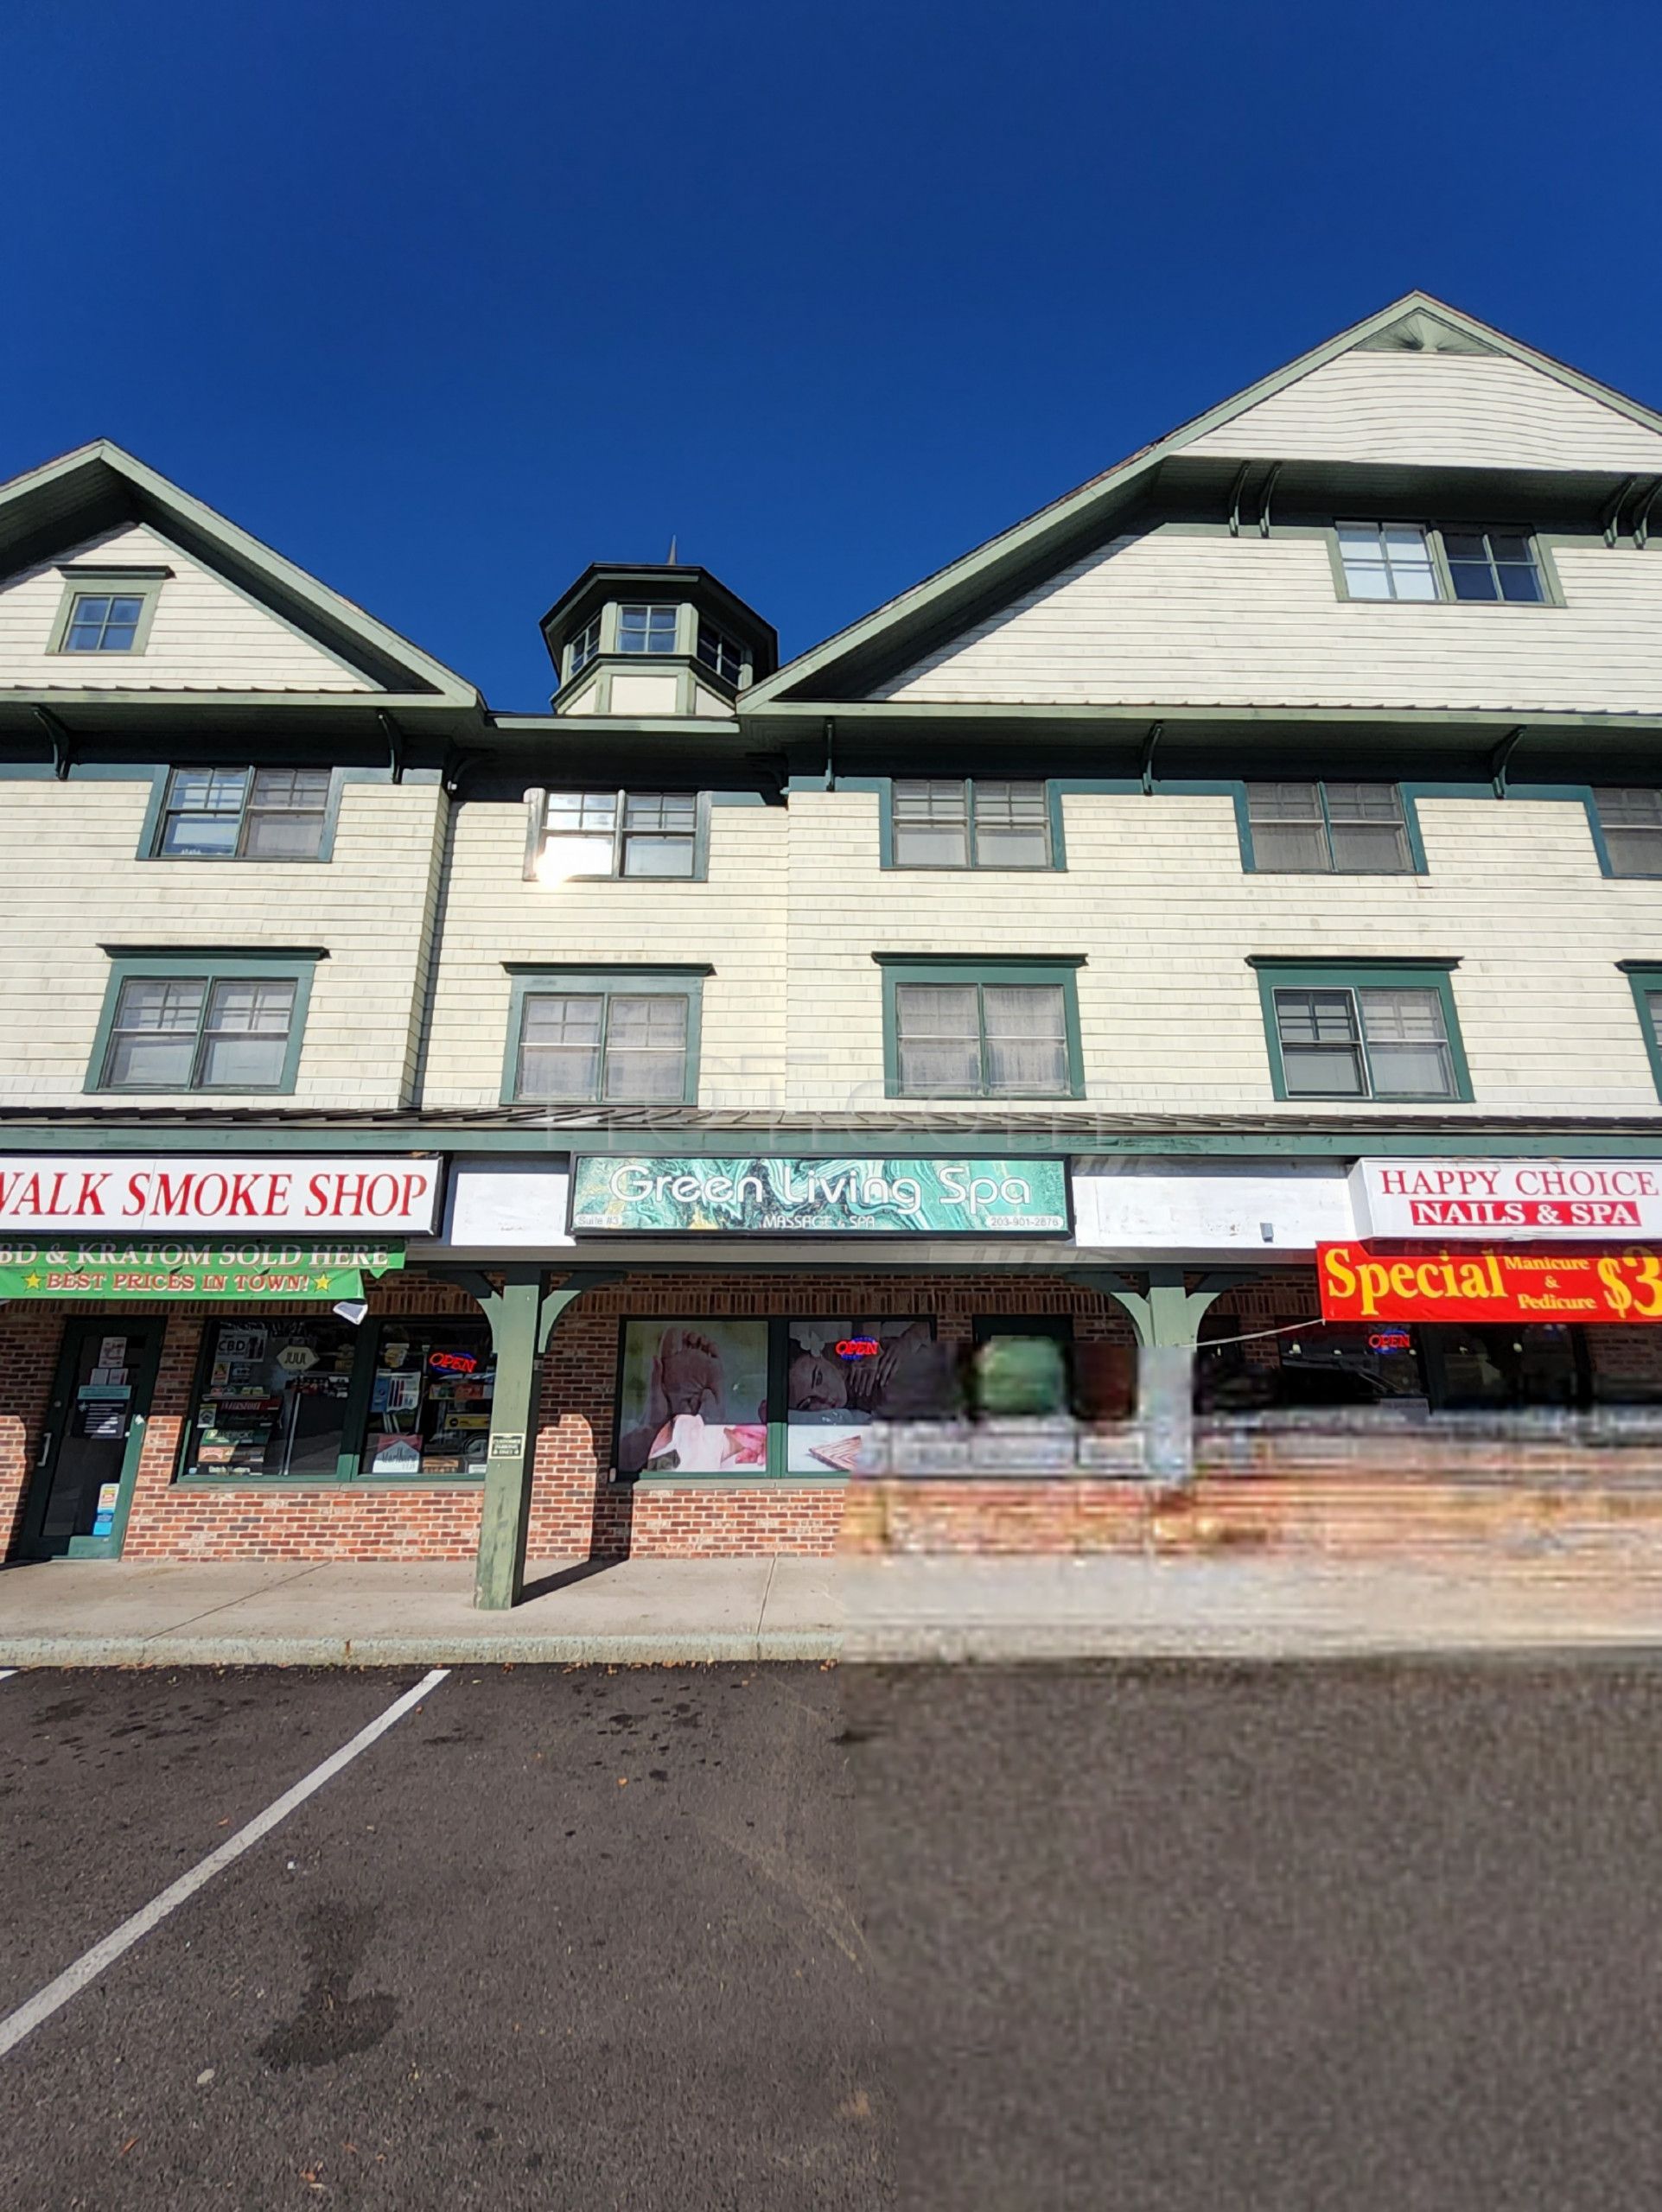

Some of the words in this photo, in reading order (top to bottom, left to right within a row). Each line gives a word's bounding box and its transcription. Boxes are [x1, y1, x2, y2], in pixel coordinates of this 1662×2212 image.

[610, 1164, 763, 1203] Green
[784, 1166, 921, 1215] Living
[939, 1166, 1030, 1216] Spa
[1379, 1170, 1500, 1195] HAPPY
[1515, 1171, 1660, 1196] CHOICE
[122, 1173, 292, 1217] SMOKE
[305, 1173, 427, 1217] SHOP
[578, 1216, 602, 1225] Suite
[606, 1215, 619, 1225] #3
[1415, 1202, 1525, 1224] NAILS
[1537, 1204, 1563, 1224] &
[1571, 1204, 1639, 1224] SPA
[850, 1216, 875, 1229] SPA
[46, 1243, 69, 1264] &
[76, 1243, 213, 1266] KRATOM
[219, 1243, 301, 1266] SOLD
[309, 1244, 389, 1266] HERE
[1503, 1255, 1590, 1270] Manicure
[46, 1273, 106, 1291] BEST
[112, 1273, 195, 1291] PRICES
[201, 1274, 228, 1292] IN
[234, 1274, 309, 1292] TOWN!
[1325, 1248, 1508, 1316] Special
[1544, 1274, 1562, 1288] &
[1517, 1294, 1597, 1310] Pedicure
[218, 1340, 245, 1351] CBD
[835, 1340, 879, 1355] OPEN
[1368, 1334, 1410, 1348] OPEN
[429, 1352, 477, 1373] OPEN
